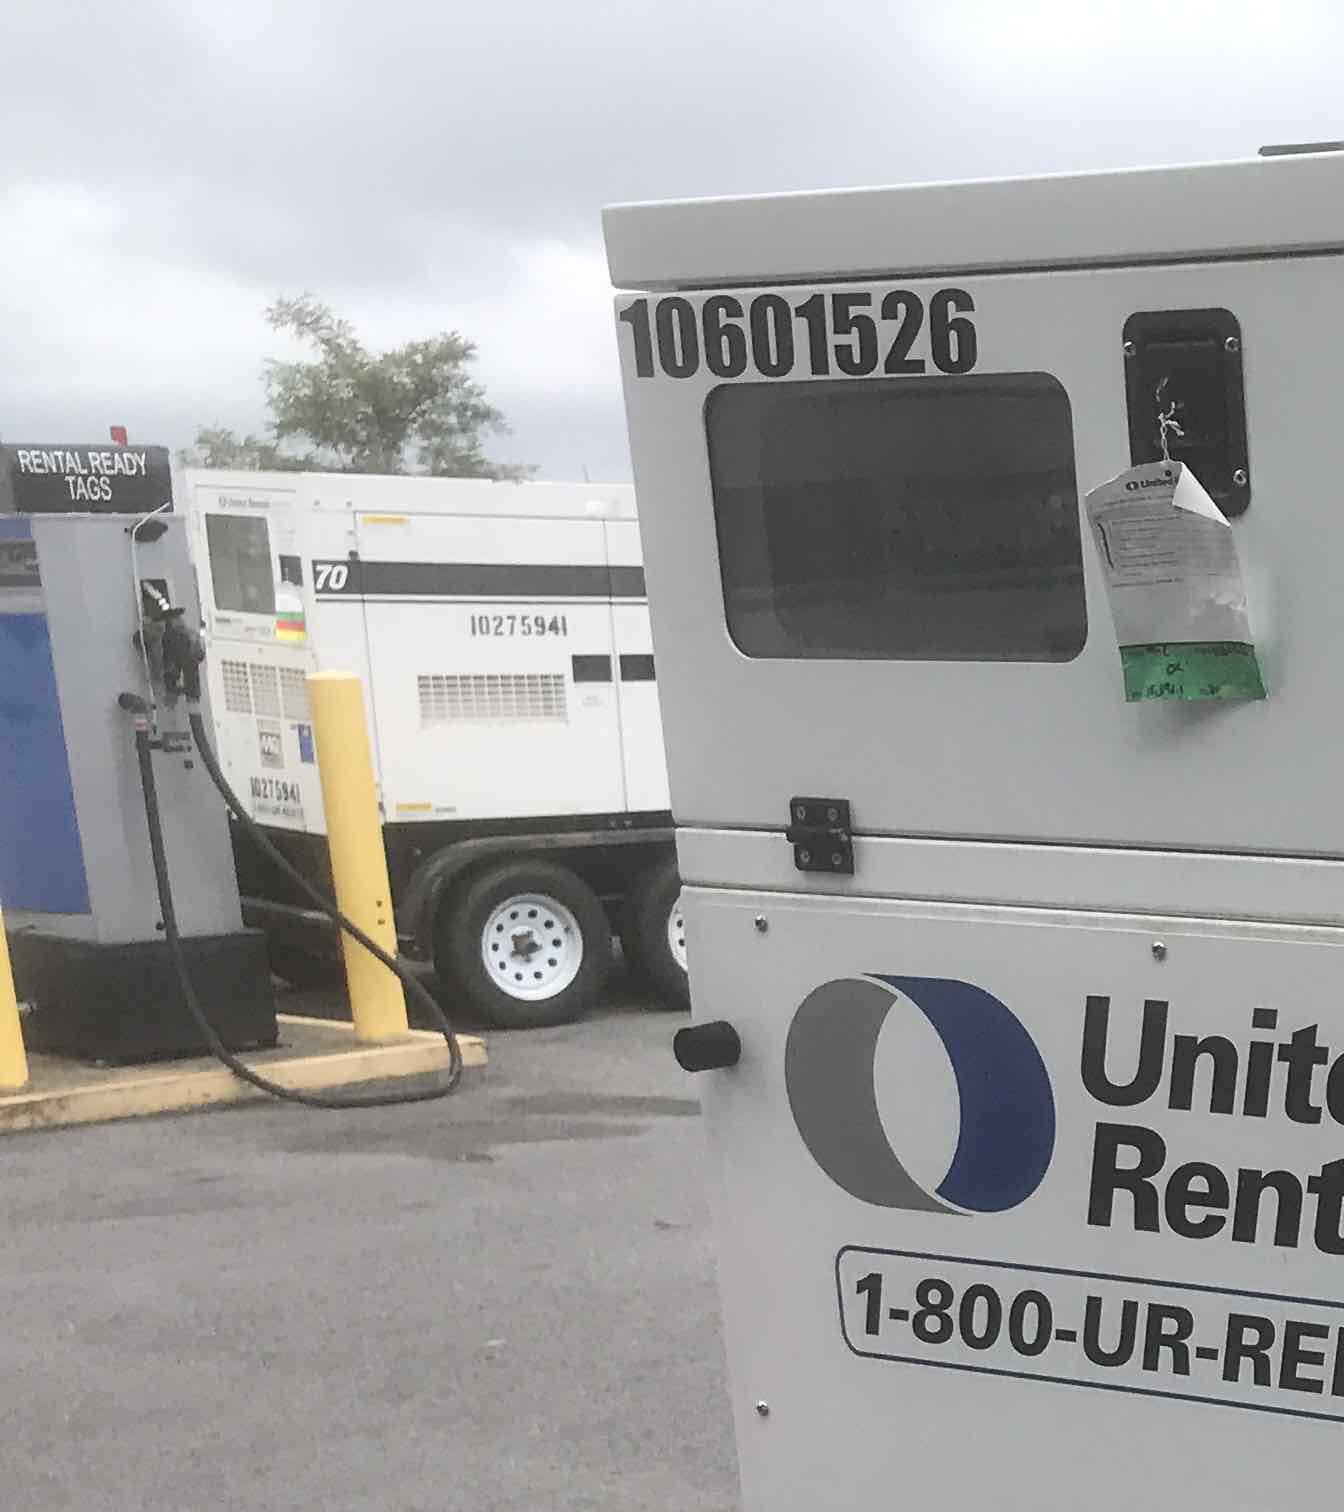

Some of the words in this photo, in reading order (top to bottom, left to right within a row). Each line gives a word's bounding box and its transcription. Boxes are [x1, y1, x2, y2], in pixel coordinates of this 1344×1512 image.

[618, 288, 979, 379] 10601526
[17, 450, 88, 474] RENTAL
[88, 451, 146, 476] READY
[64, 476, 113, 500] TAGS
[314, 564, 348, 590] 70
[470, 614, 568, 637] 10275941
